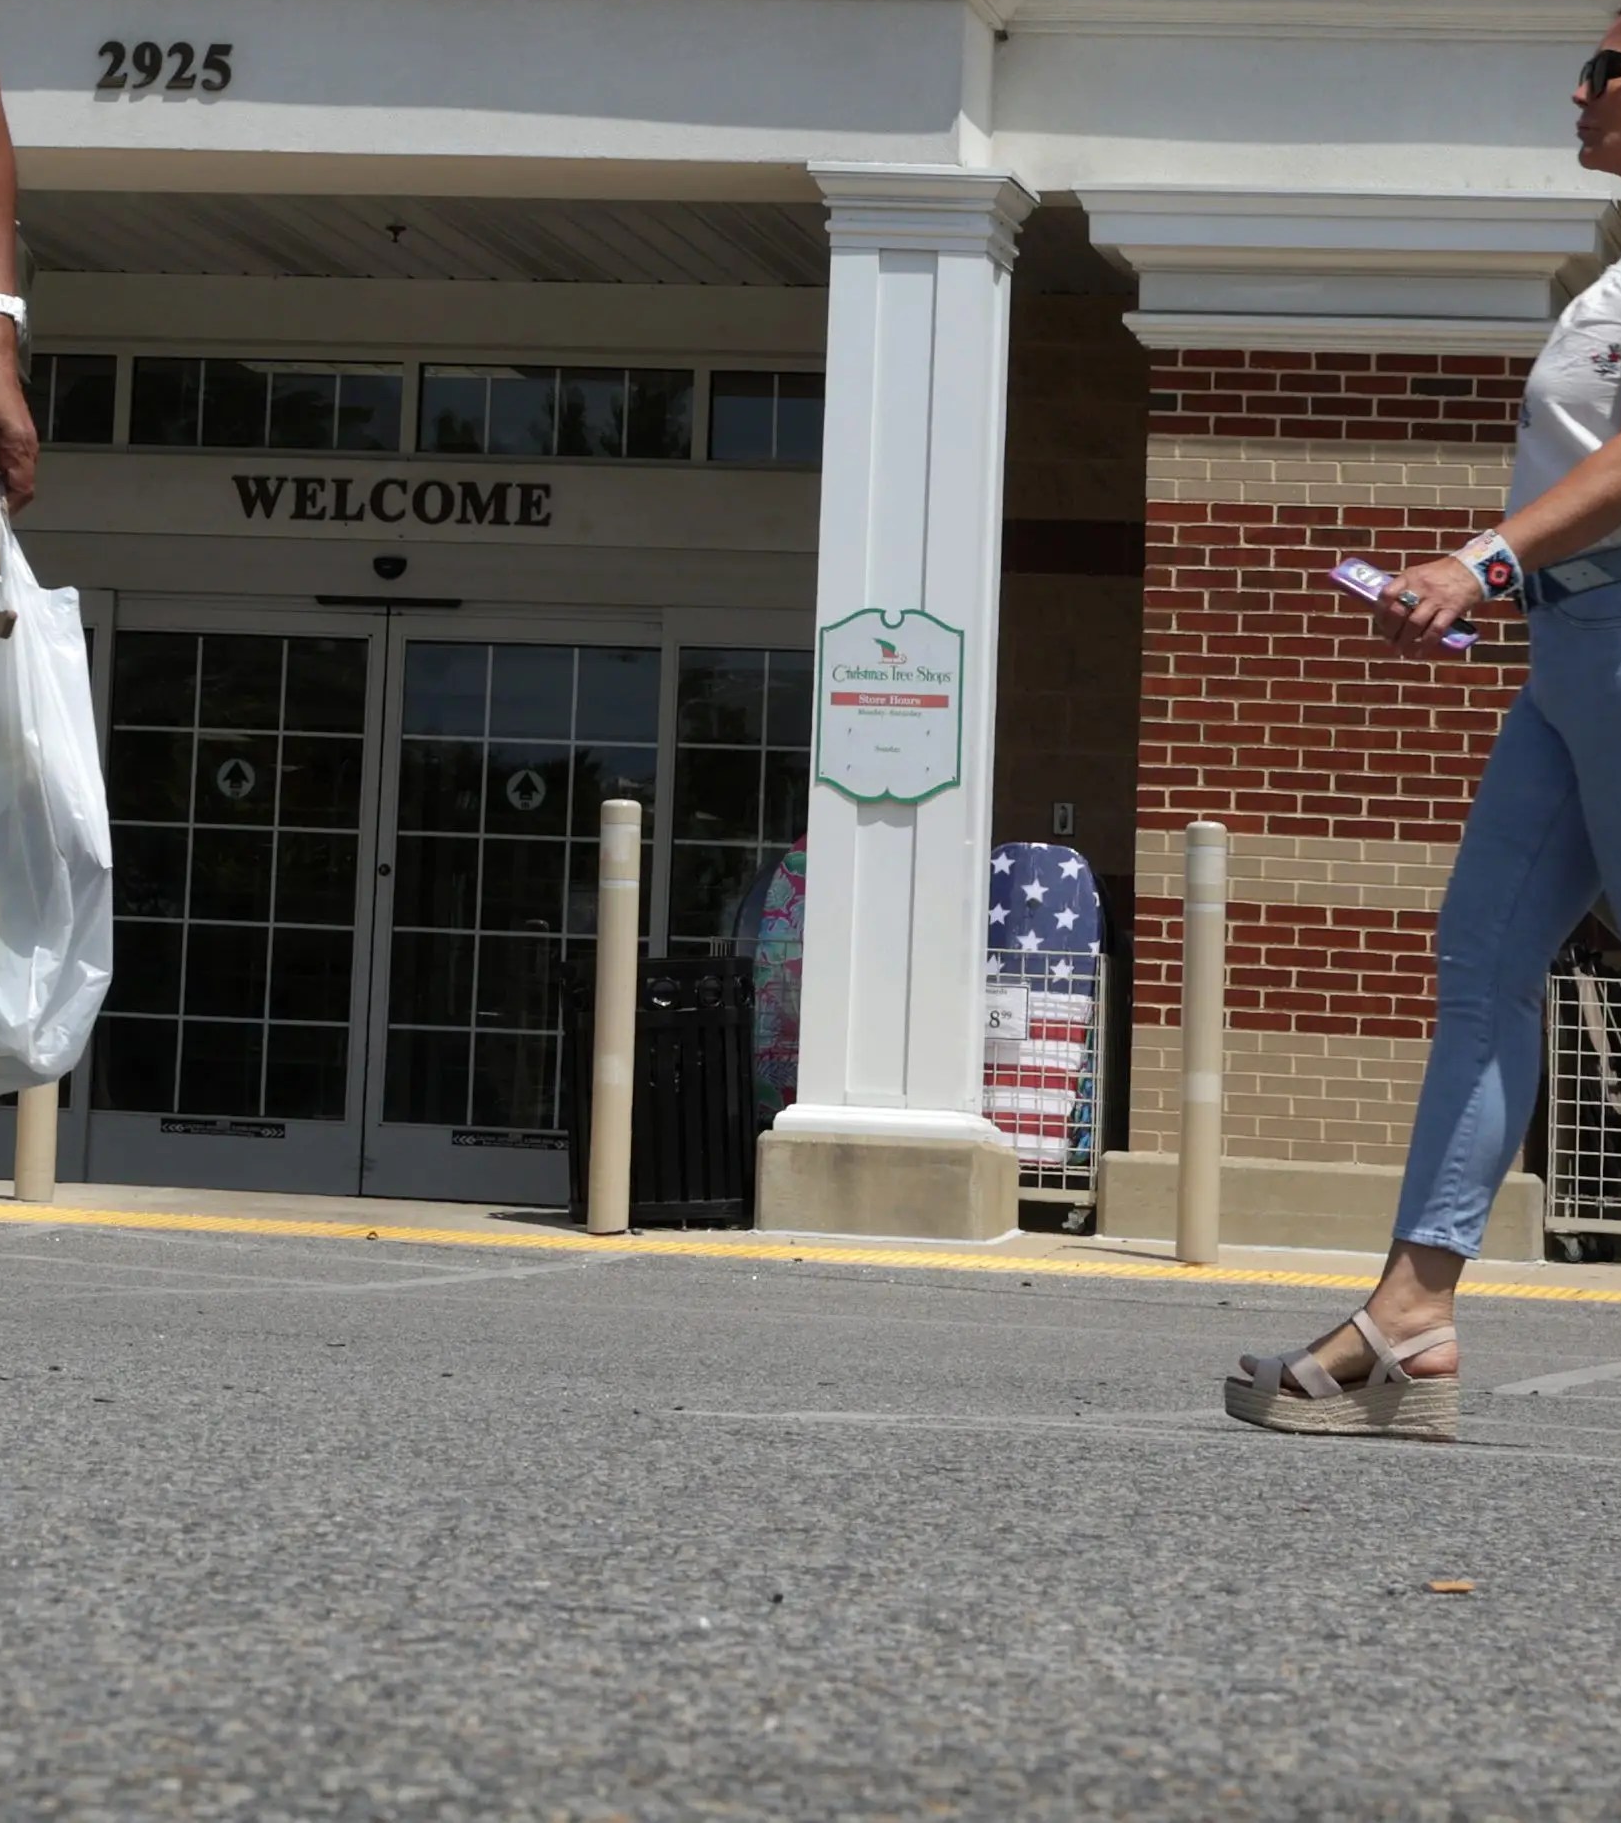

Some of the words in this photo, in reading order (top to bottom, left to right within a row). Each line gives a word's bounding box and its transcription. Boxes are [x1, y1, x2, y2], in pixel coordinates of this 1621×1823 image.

[96, 40, 233, 92] 2925
[232, 475, 552, 527] WELCOME
[832, 664, 889, 683] Christmas
[891, 665, 914, 681] Tree
[916, 666, 952, 685] Shops
[858, 694, 886, 705] Store
[889, 695, 921, 706] Hours
